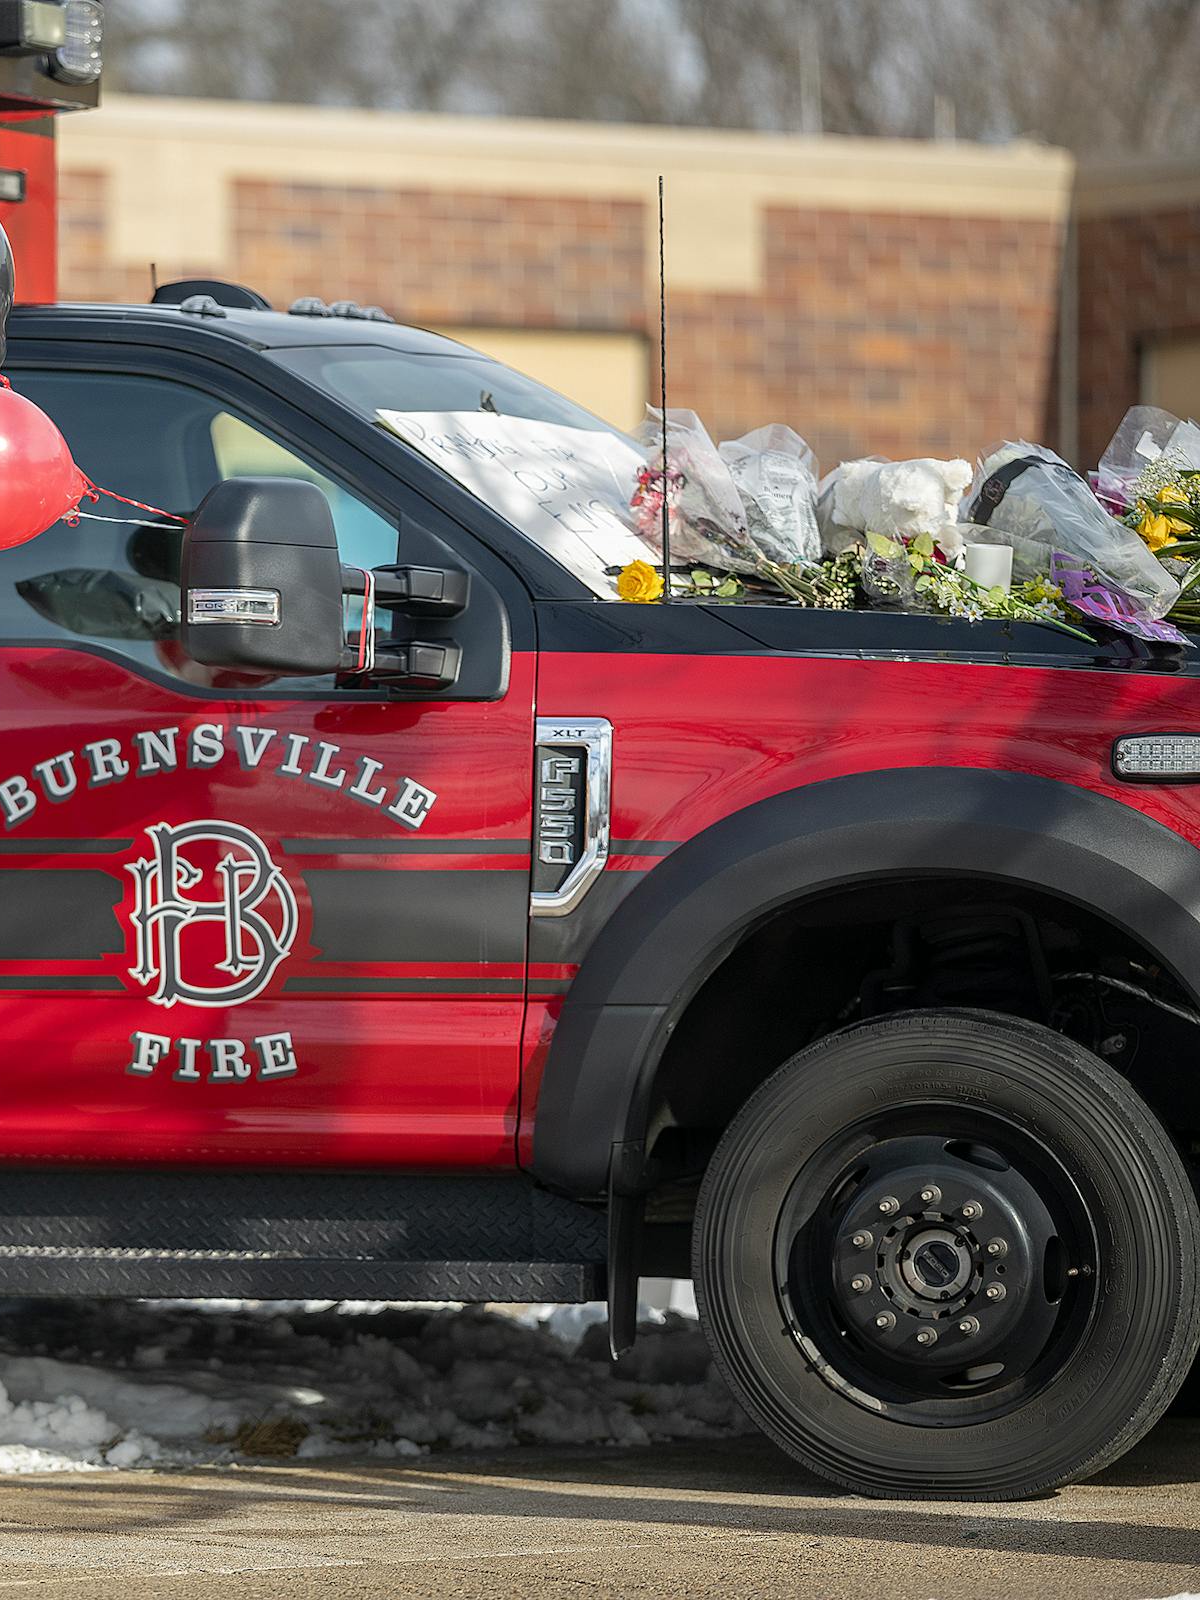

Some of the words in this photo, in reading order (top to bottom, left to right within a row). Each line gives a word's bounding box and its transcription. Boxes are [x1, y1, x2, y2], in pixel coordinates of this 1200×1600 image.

[553, 729, 586, 737] XLT
[538, 757, 580, 865] F550
[127, 1031, 299, 1082] FIRE
